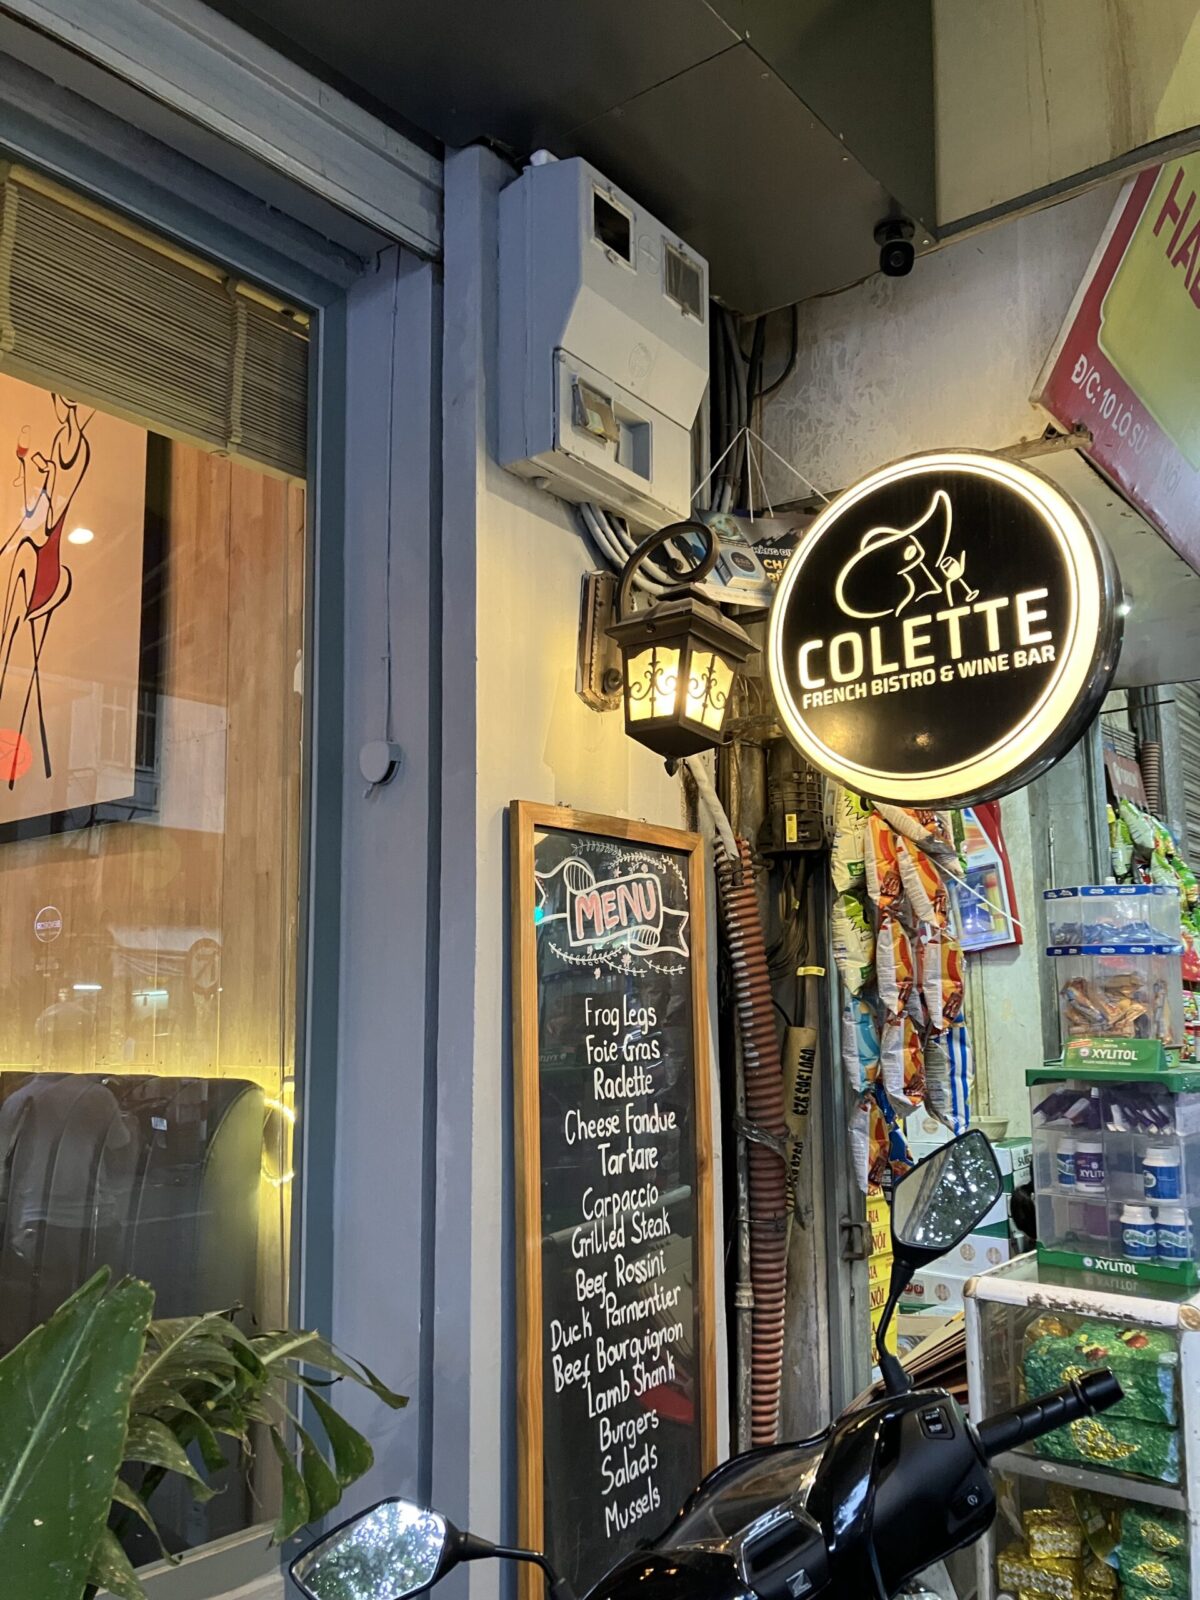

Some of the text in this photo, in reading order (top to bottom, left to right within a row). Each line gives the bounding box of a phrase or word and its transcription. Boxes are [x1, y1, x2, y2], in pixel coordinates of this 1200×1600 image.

[1100, 388, 1117, 420] 10
[798, 587, 1052, 689] COLETTE
[802, 645, 1056, 709] FRENCH BISTRO & WINE BAR
[575, 880, 656, 939] MENU
[585, 994, 657, 1036] Frog Legs
[585, 1034, 660, 1064] Foie Gras
[1091, 1048, 1138, 1060] XYLITOL
[594, 1064, 655, 1100] Raclette
[565, 1102, 677, 1145] Cheese Fondue
[597, 1136, 659, 1176] Tartare
[582, 1183, 659, 1230] Carpaccio
[571, 1206, 671, 1259] Grilled Steak
[575, 1250, 666, 1309] Beef Rossini
[1095, 1259, 1138, 1275] XYLITOL
[550, 1283, 681, 1351] Duck Parmentier
[552, 1353, 591, 1393] Beef
[588, 1351, 676, 1418] Lamb Shank
[600, 1409, 659, 1452] Burgers
[601, 1443, 658, 1495] Salads
[605, 1476, 661, 1538] Mussels
